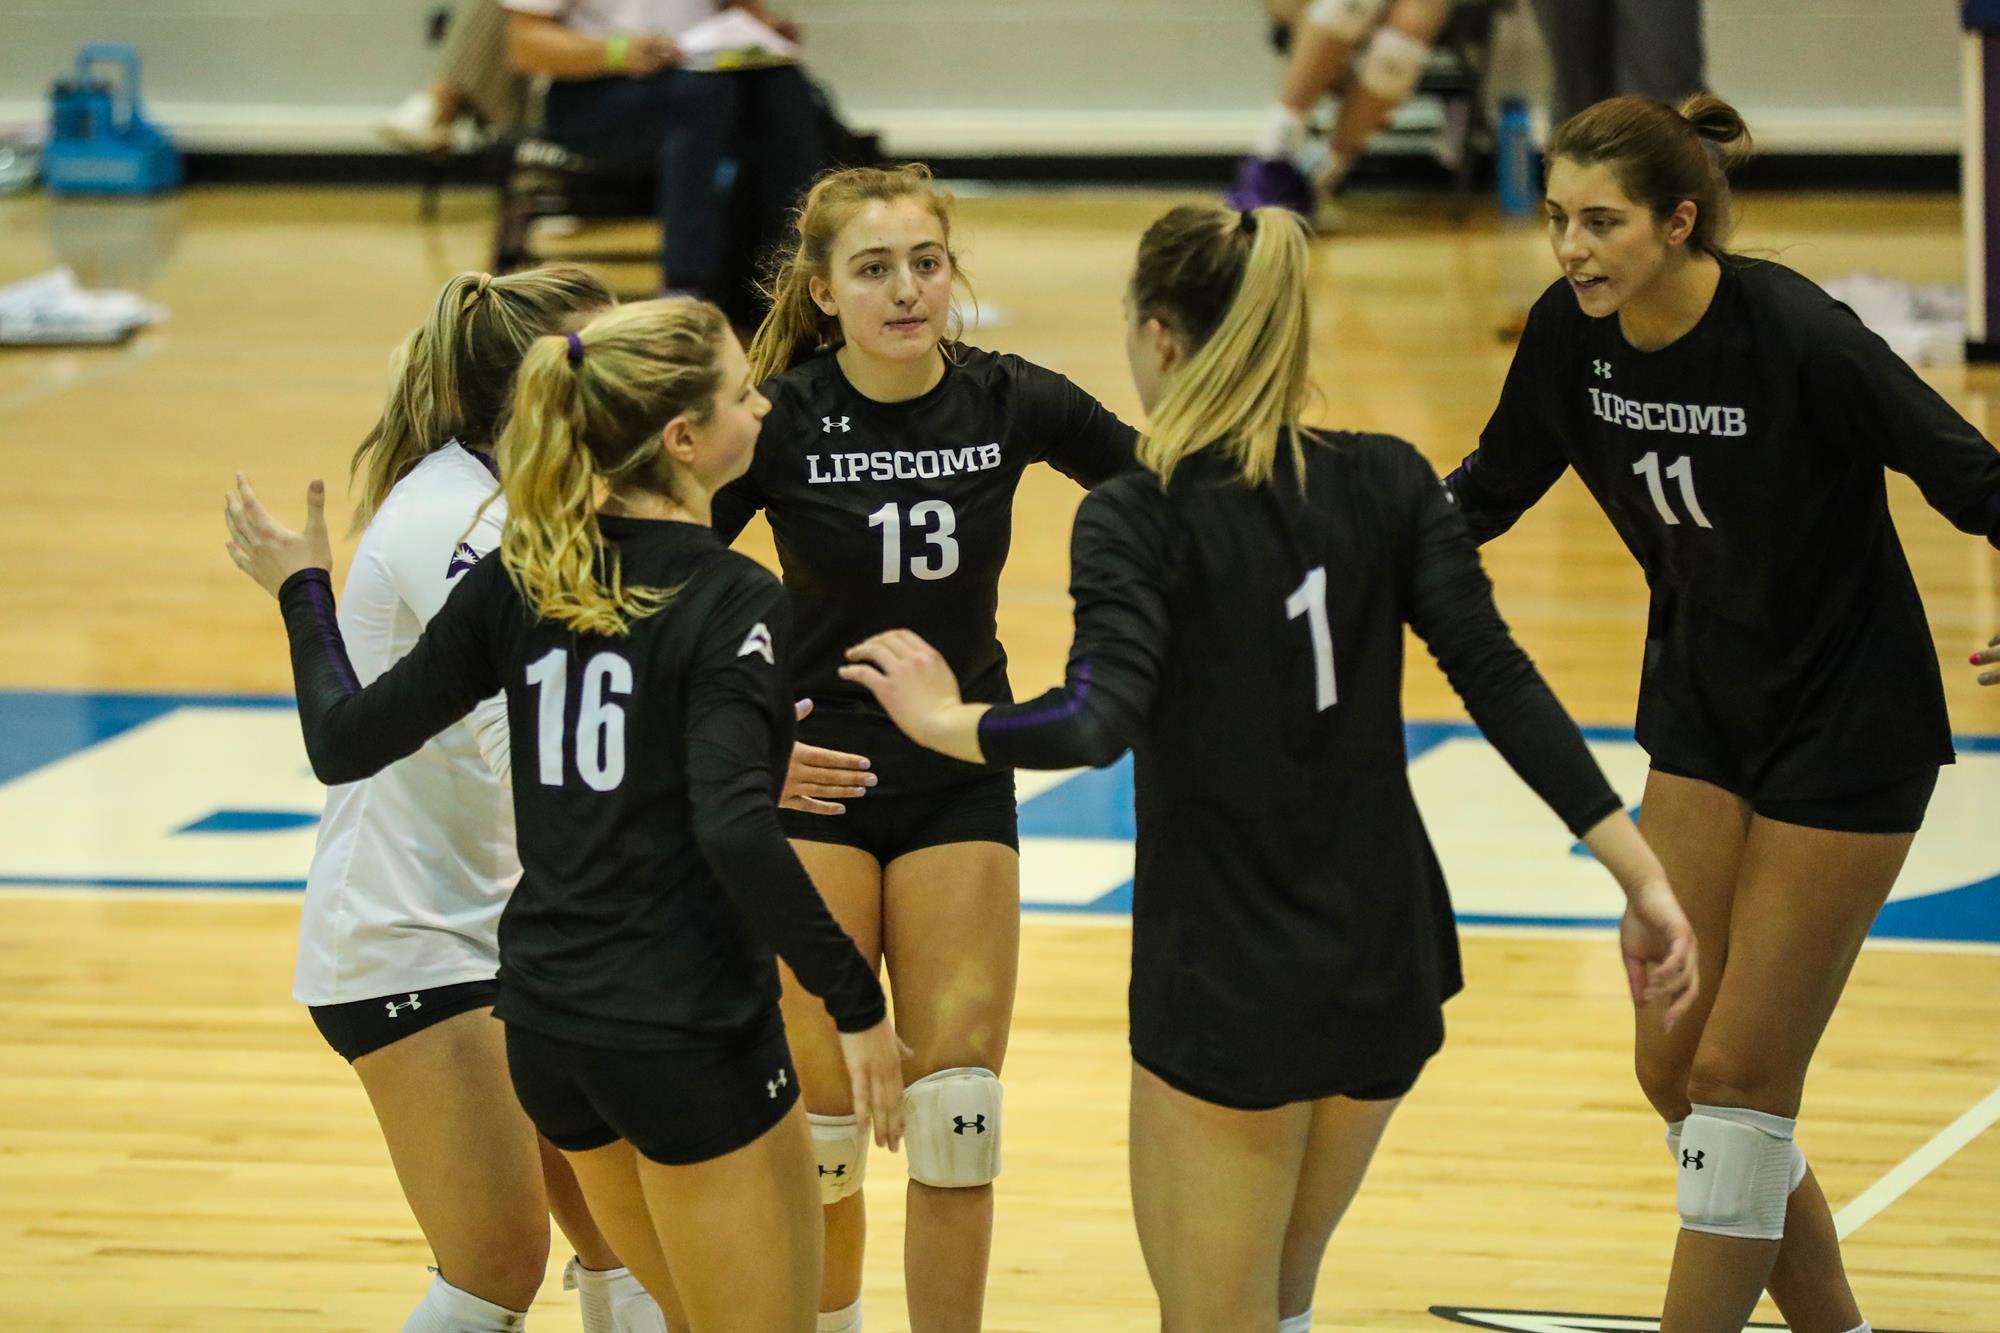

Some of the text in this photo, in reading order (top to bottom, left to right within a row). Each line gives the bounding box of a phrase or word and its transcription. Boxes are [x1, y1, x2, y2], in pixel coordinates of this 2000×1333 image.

[1588, 388, 1748, 438] LIPSCOMB
[806, 442, 1002, 484] LIPSCOMB
[1632, 451, 1713, 529] 11
[868, 499, 960, 584] 13
[1286, 566, 1338, 711] 1
[525, 648, 634, 792] 16
